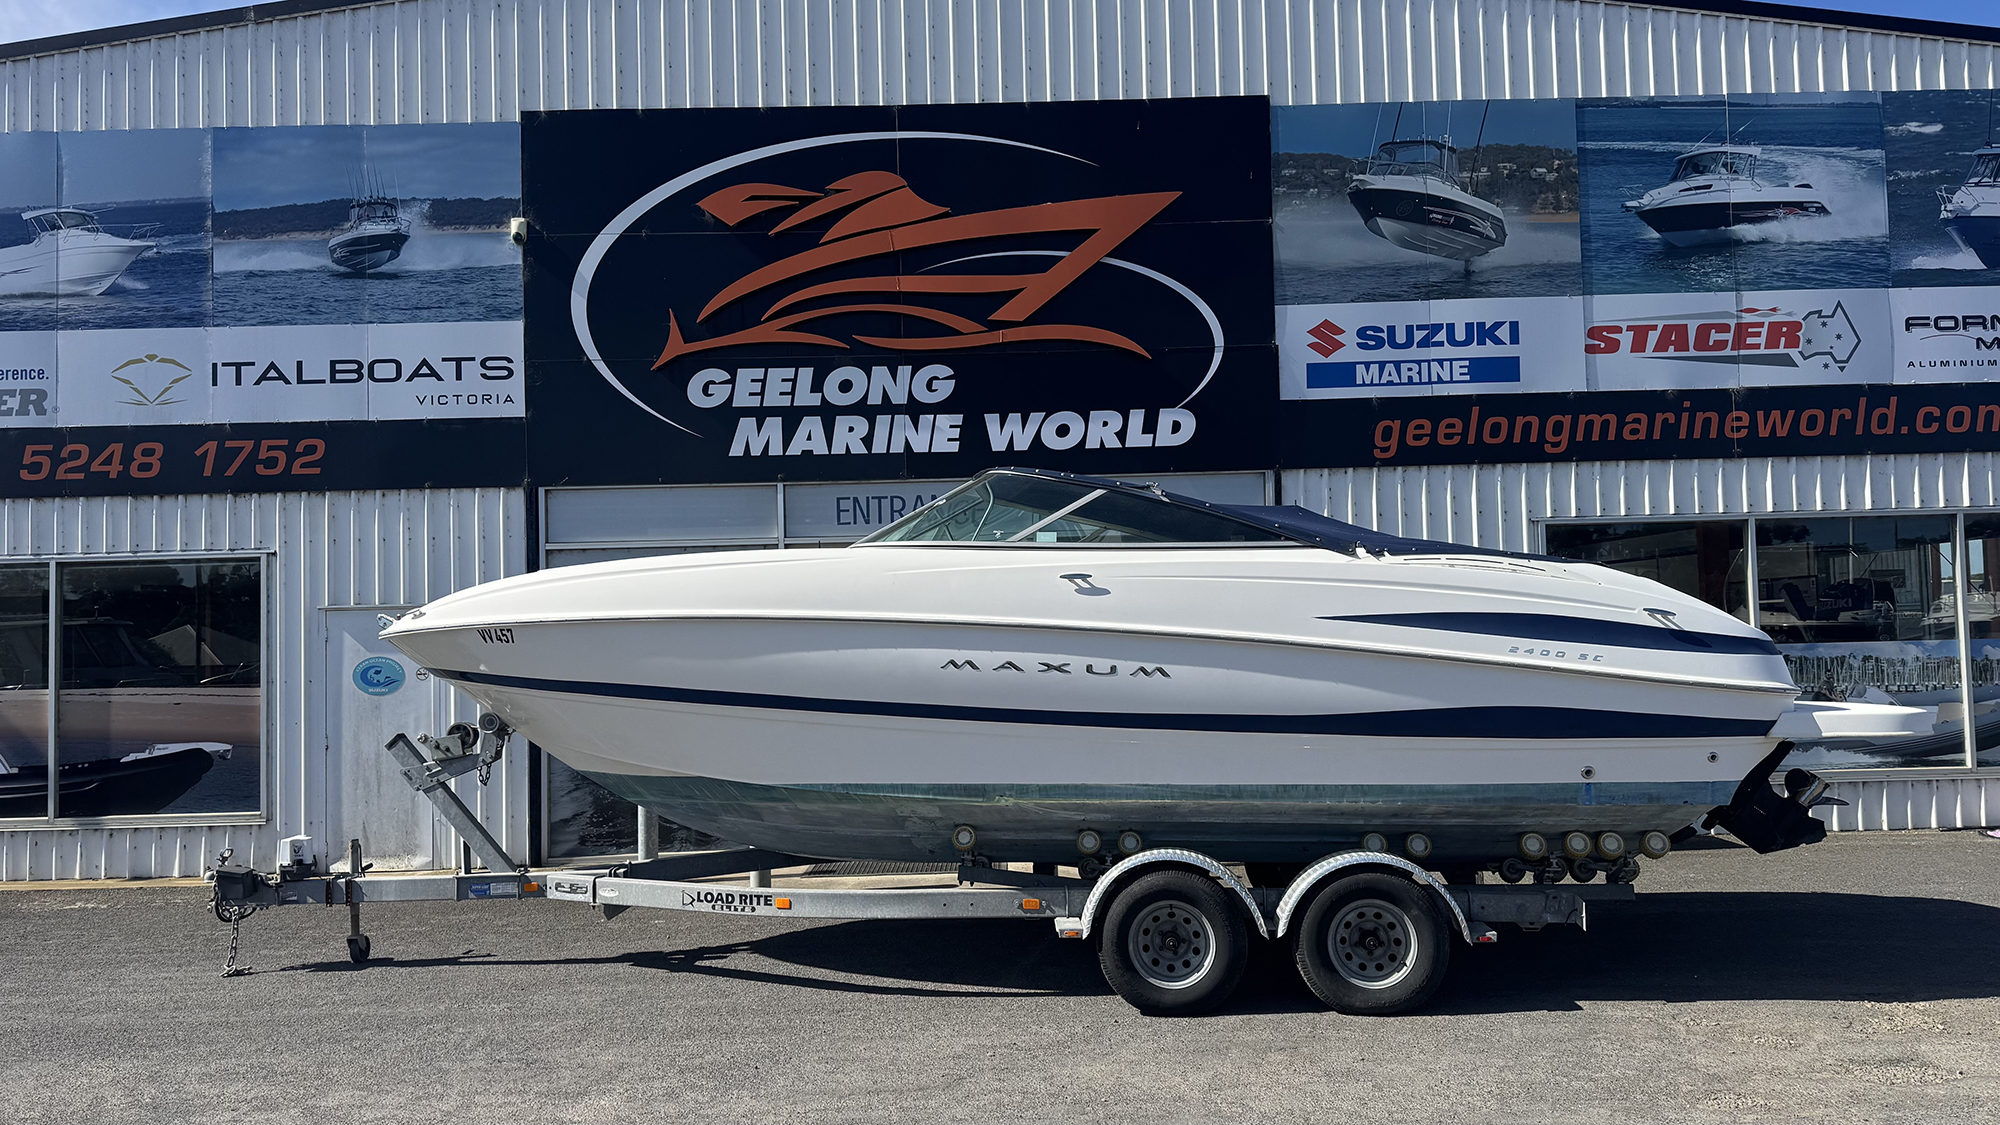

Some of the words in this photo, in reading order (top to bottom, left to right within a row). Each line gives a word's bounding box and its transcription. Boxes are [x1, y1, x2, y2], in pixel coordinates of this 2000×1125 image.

[1356, 320, 1520, 351] SUZUKI
[1584, 320, 1804, 355] STACER
[212, 356, 515, 387] ITALBOATS
[1356, 360, 1470, 385] MARINE
[1907, 359, 1998, 368] ALUMINIUM
[687, 363, 956, 408] GEELONG
[416, 392, 515, 406] VICTORIA
[729, 414, 963, 457] MARINE
[985, 408, 1197, 453] WORLD
[19, 441, 165, 481] 5248
[194, 438, 326, 476] 1752
[494, 628, 515, 644] 457
[1508, 646, 1566, 658] 2400
[1578, 653, 1604, 662] SC
[940, 658, 1172, 679] MAXUM
[696, 891, 736, 905] LOAD
[738, 893, 773, 906] RITE
